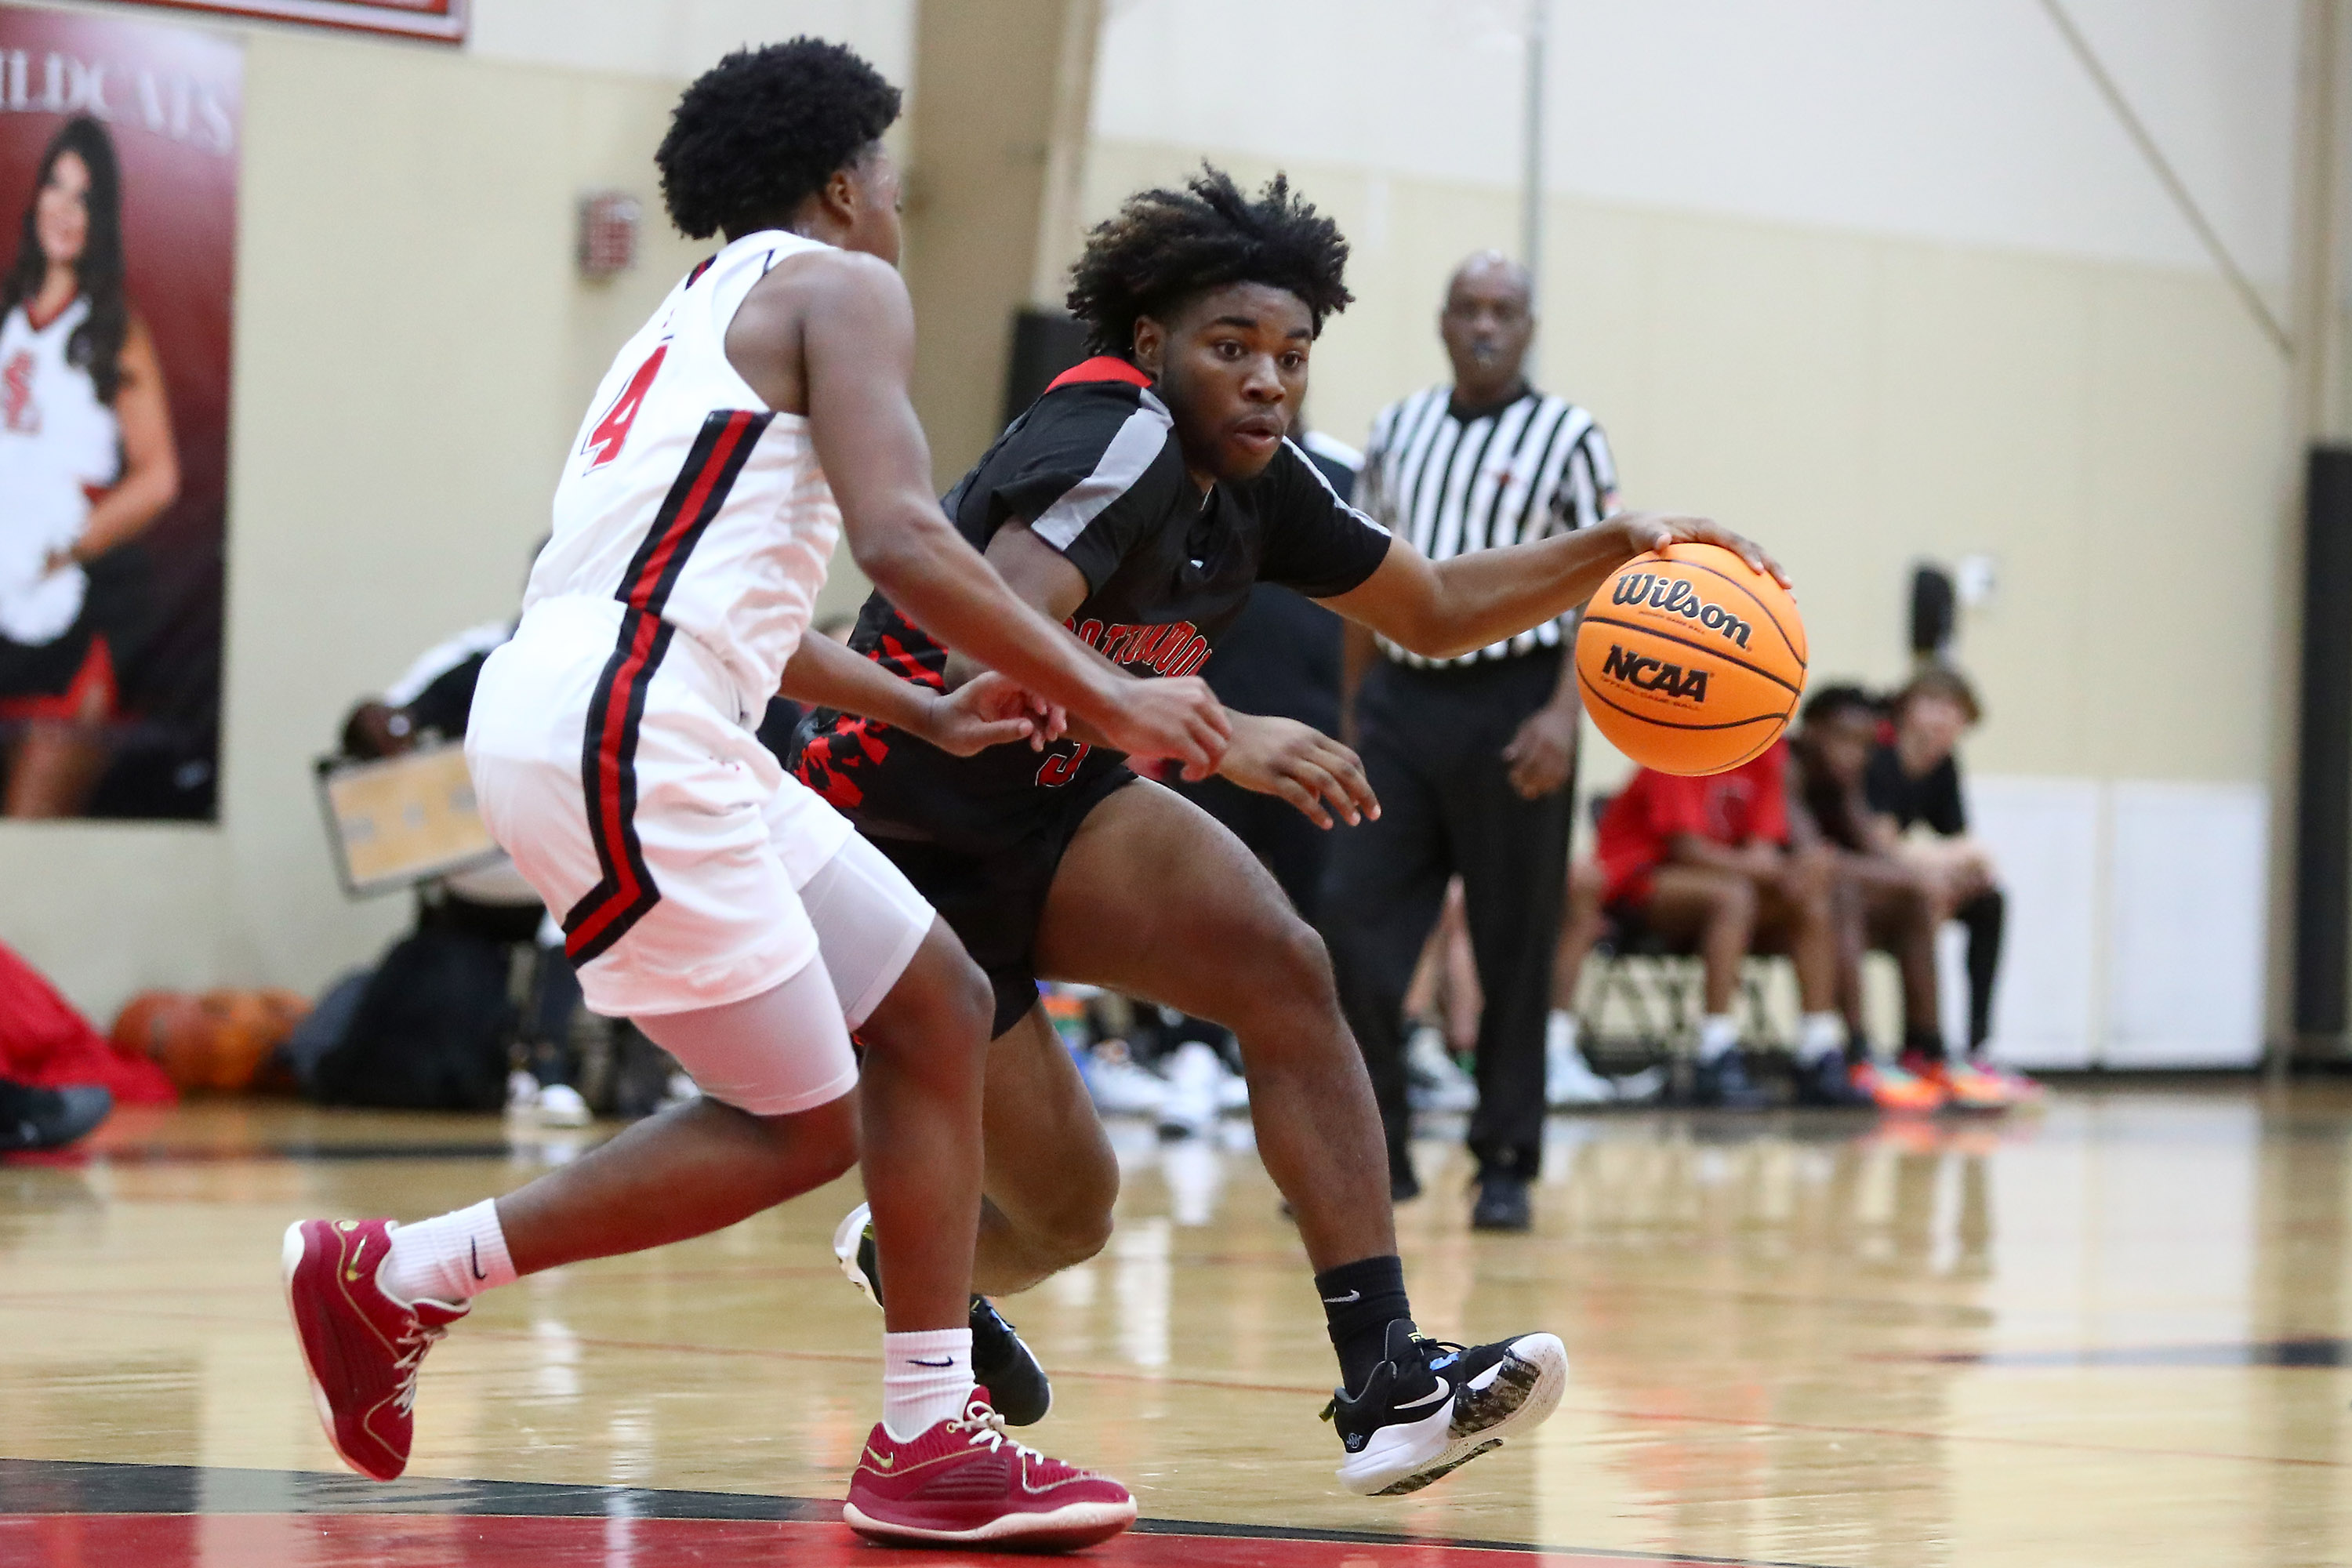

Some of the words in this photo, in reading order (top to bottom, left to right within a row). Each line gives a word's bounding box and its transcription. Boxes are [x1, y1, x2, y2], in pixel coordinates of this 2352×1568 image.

[581, 337, 670, 476] 4
[1612, 574, 1752, 650] Wilson
[1602, 644, 1708, 702] NCAA
